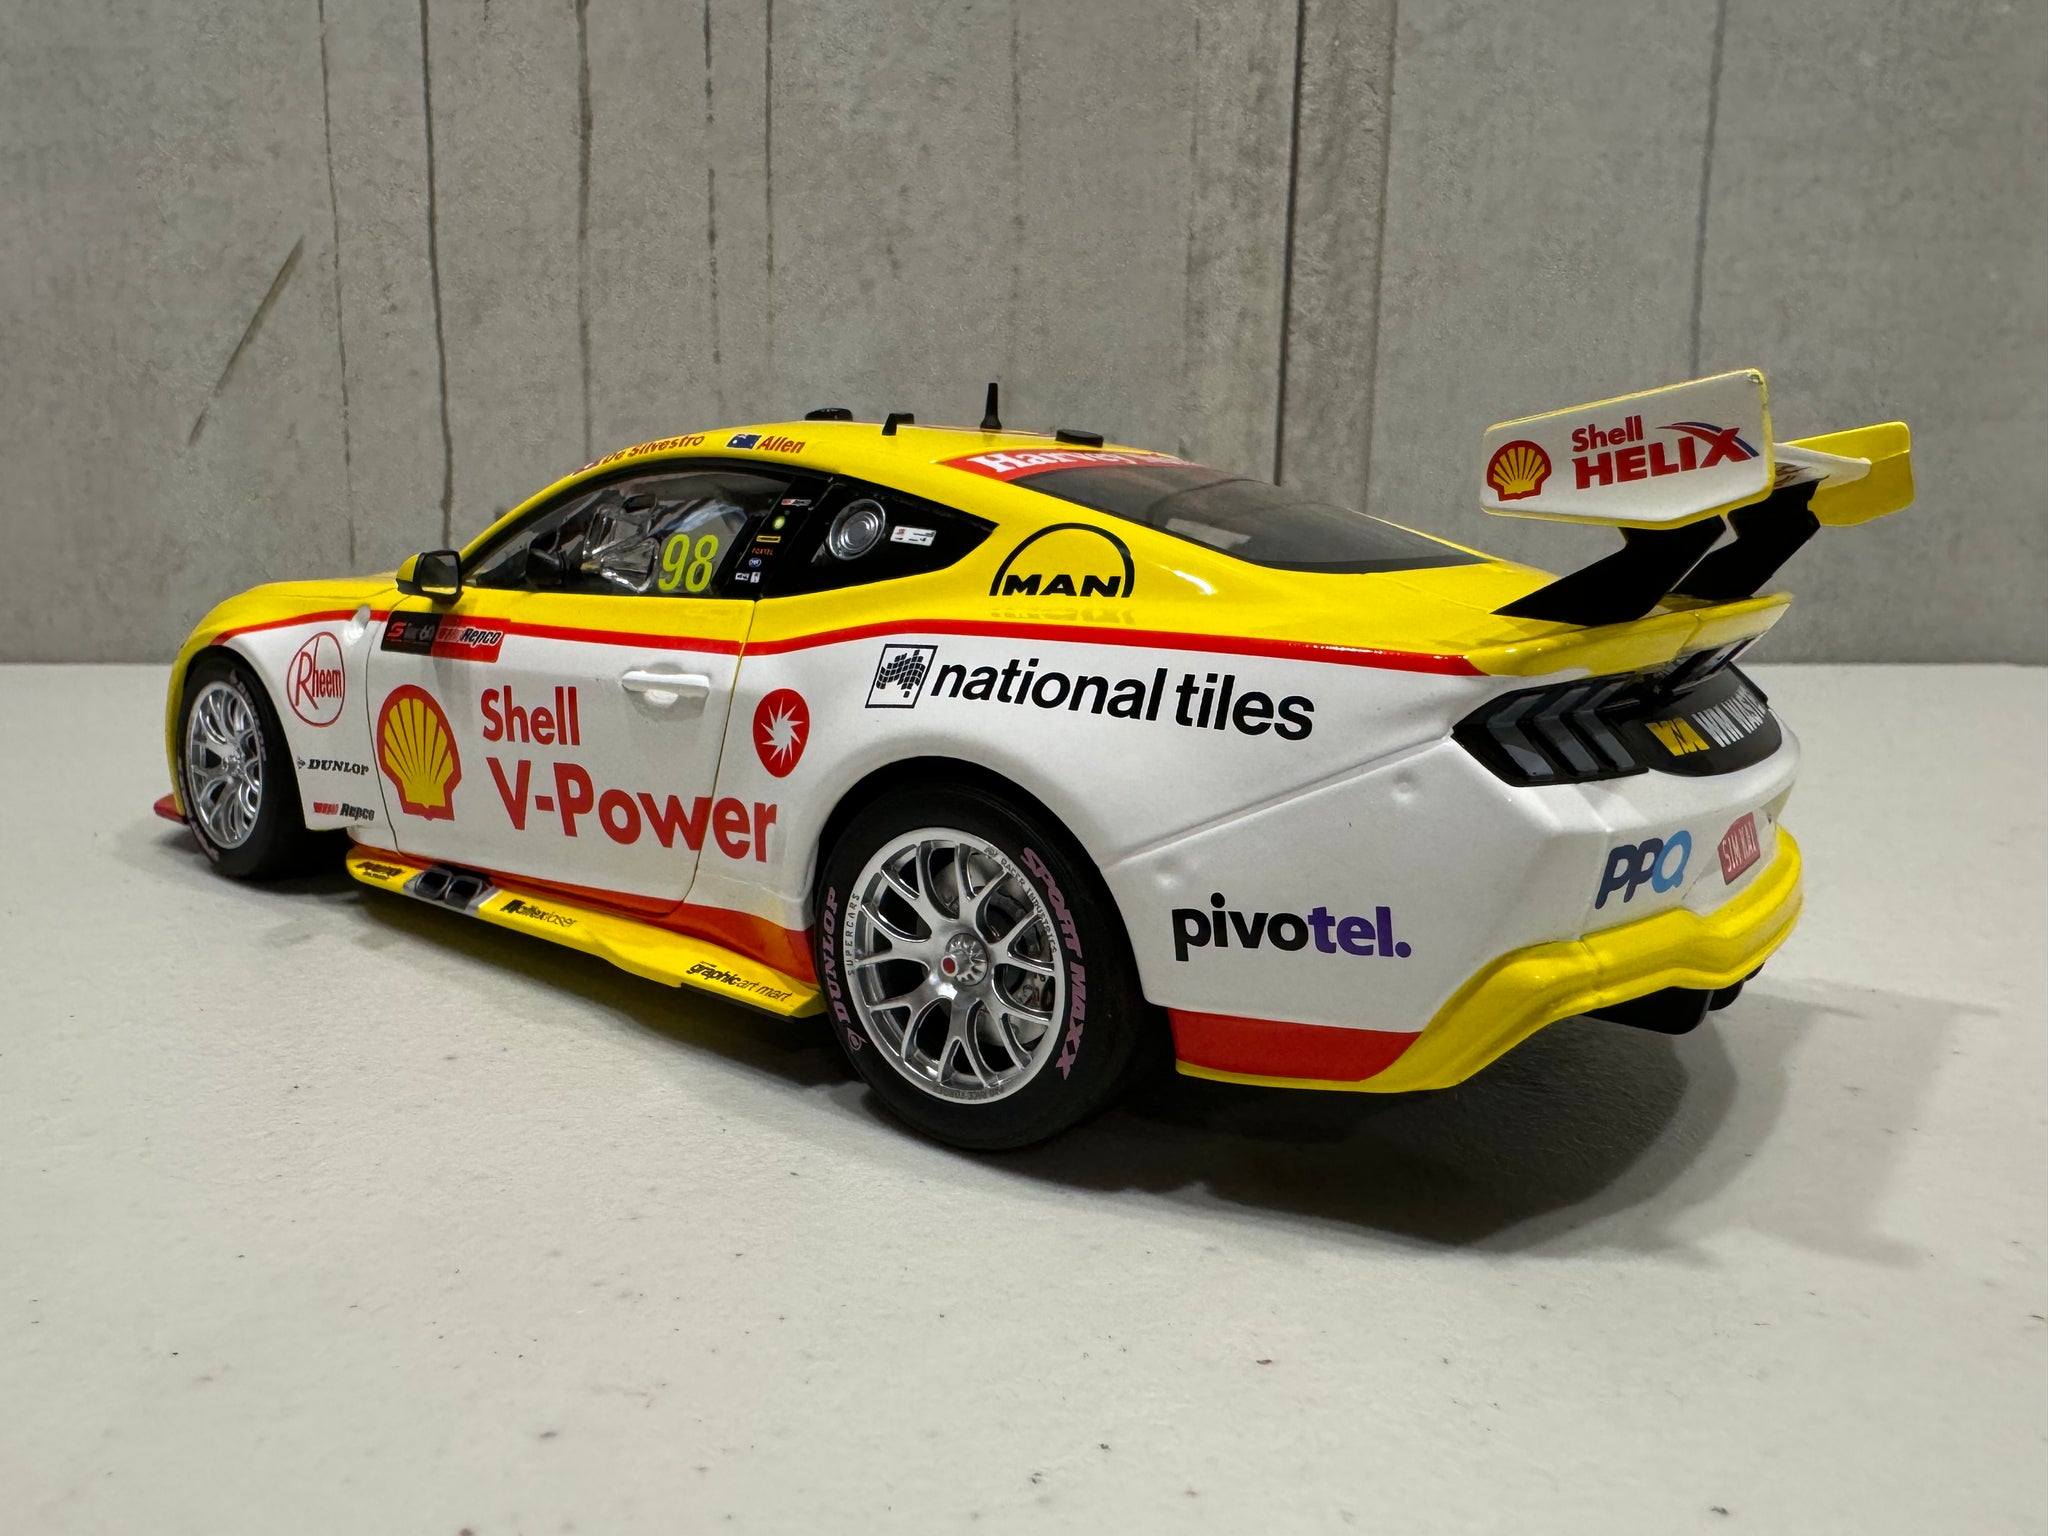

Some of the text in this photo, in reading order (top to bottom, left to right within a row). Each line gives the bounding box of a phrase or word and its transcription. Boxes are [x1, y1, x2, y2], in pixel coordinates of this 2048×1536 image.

[627, 435, 706, 457] Silvestro
[757, 435, 806, 454] Allen
[1571, 415, 1644, 453] Shell
[1571, 427, 1754, 490] HELIX
[658, 533, 719, 592] 98
[1002, 573, 1122, 598] MAN
[460, 627, 502, 645] Repco
[295, 636, 343, 711] Rheem
[930, 657, 1316, 741] national tiles
[480, 685, 581, 746] Shell
[307, 758, 369, 776] DUNLOP
[340, 802, 375, 821] Repco
[486, 757, 778, 863] V-Power
[1594, 830, 1692, 910] PPQ
[1020, 846, 1083, 959] SPORT
[1171, 892, 1412, 962] pivotel.
[823, 886, 851, 1025] DUNLOP
[845, 893, 860, 976] SUPERCARS
